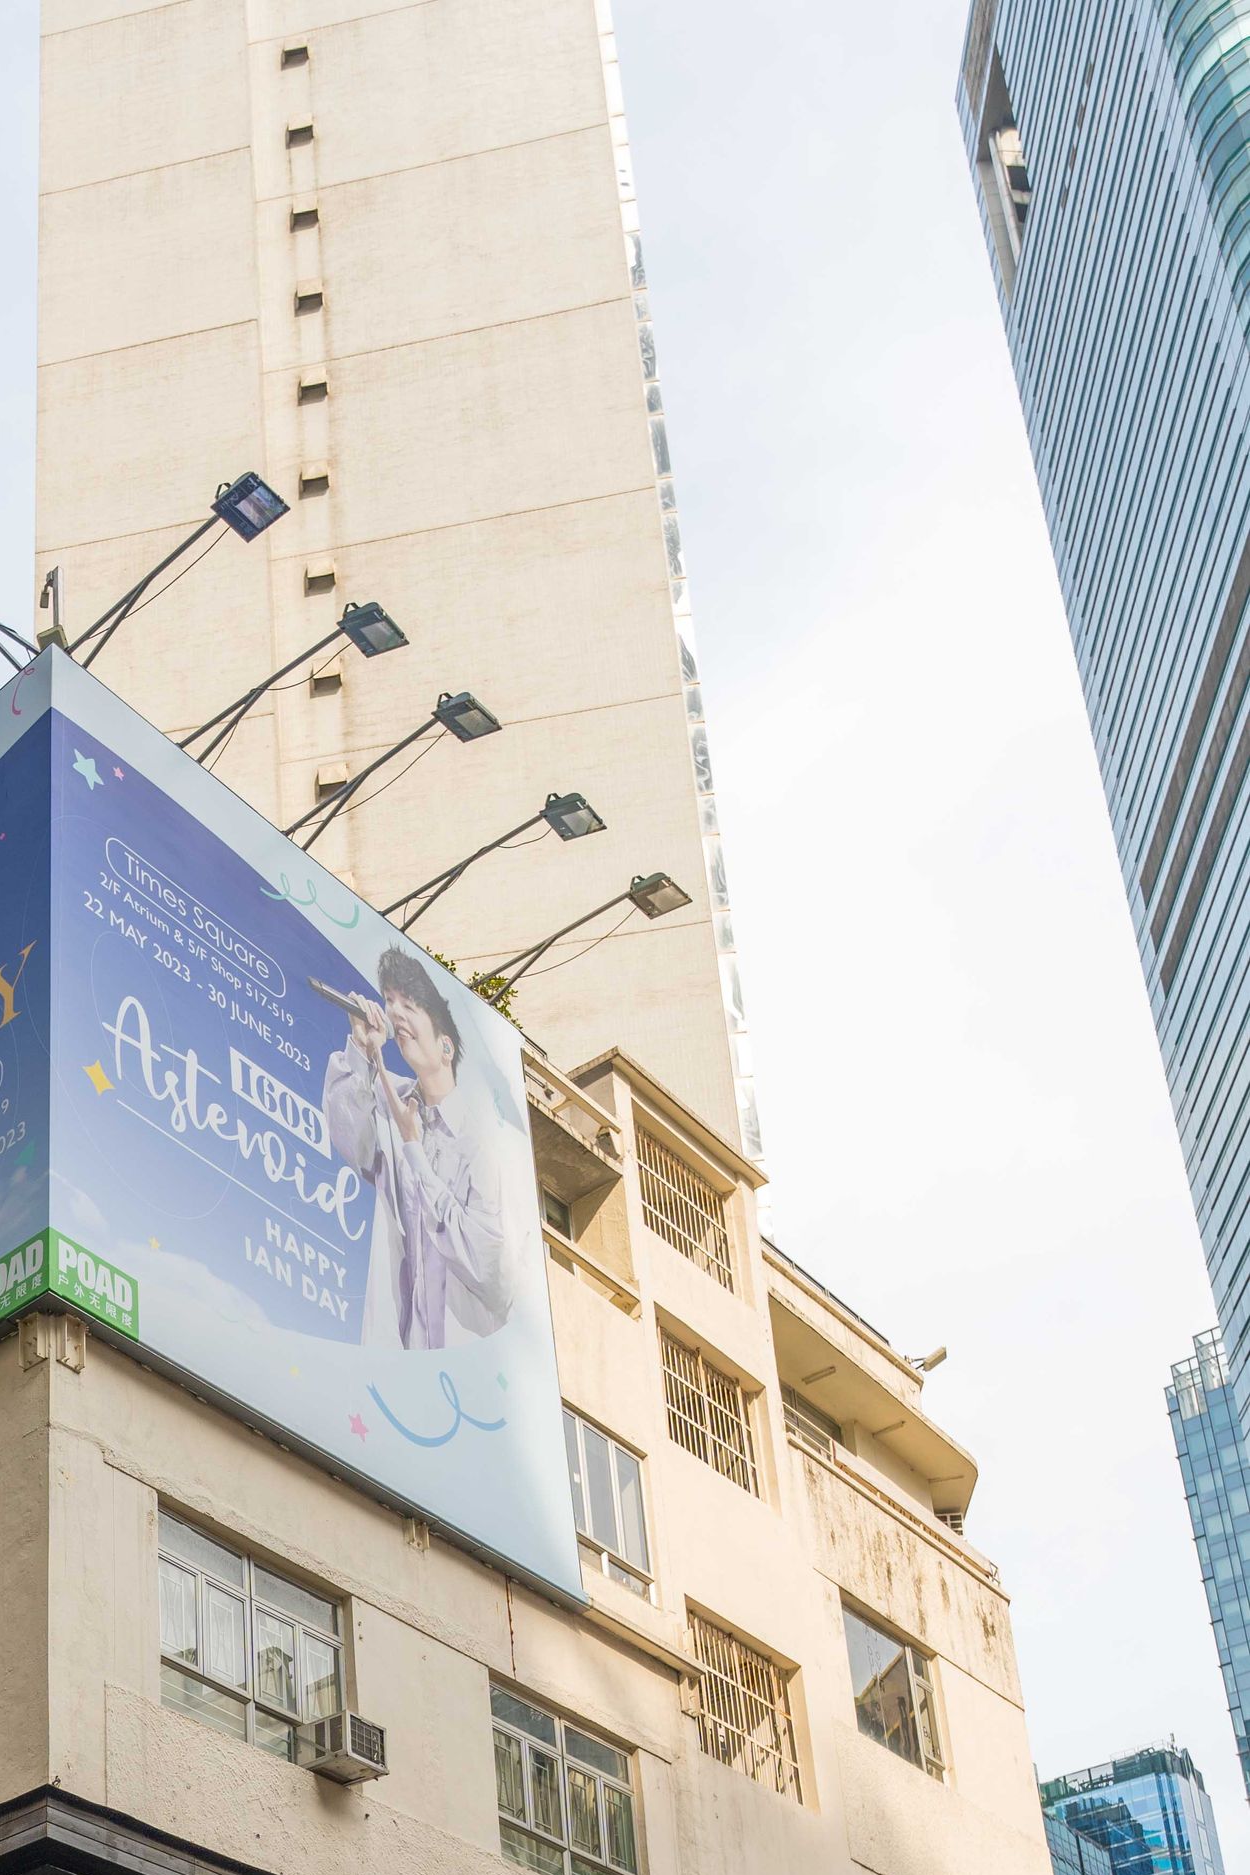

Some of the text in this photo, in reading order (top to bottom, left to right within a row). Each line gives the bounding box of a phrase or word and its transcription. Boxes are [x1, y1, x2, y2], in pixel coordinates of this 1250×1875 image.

[100, 871, 294, 1026] 2/F Atrium & 5/F Shop 517-519
[124, 851, 270, 979] Times Square
[83, 891, 105, 919] 22
[110, 910, 148, 949] MAY
[153, 943, 191, 982] 2023
[208, 983, 227, 1009] 30
[230, 1001, 272, 1044] JUNE
[276, 1034, 311, 1072] 2023
[101, 995, 367, 1241] Asteroid
[57, 1238, 133, 1313] POAD
[244, 1236, 350, 1323] IAN DAY
[264, 1217, 348, 1290] HAPPY
